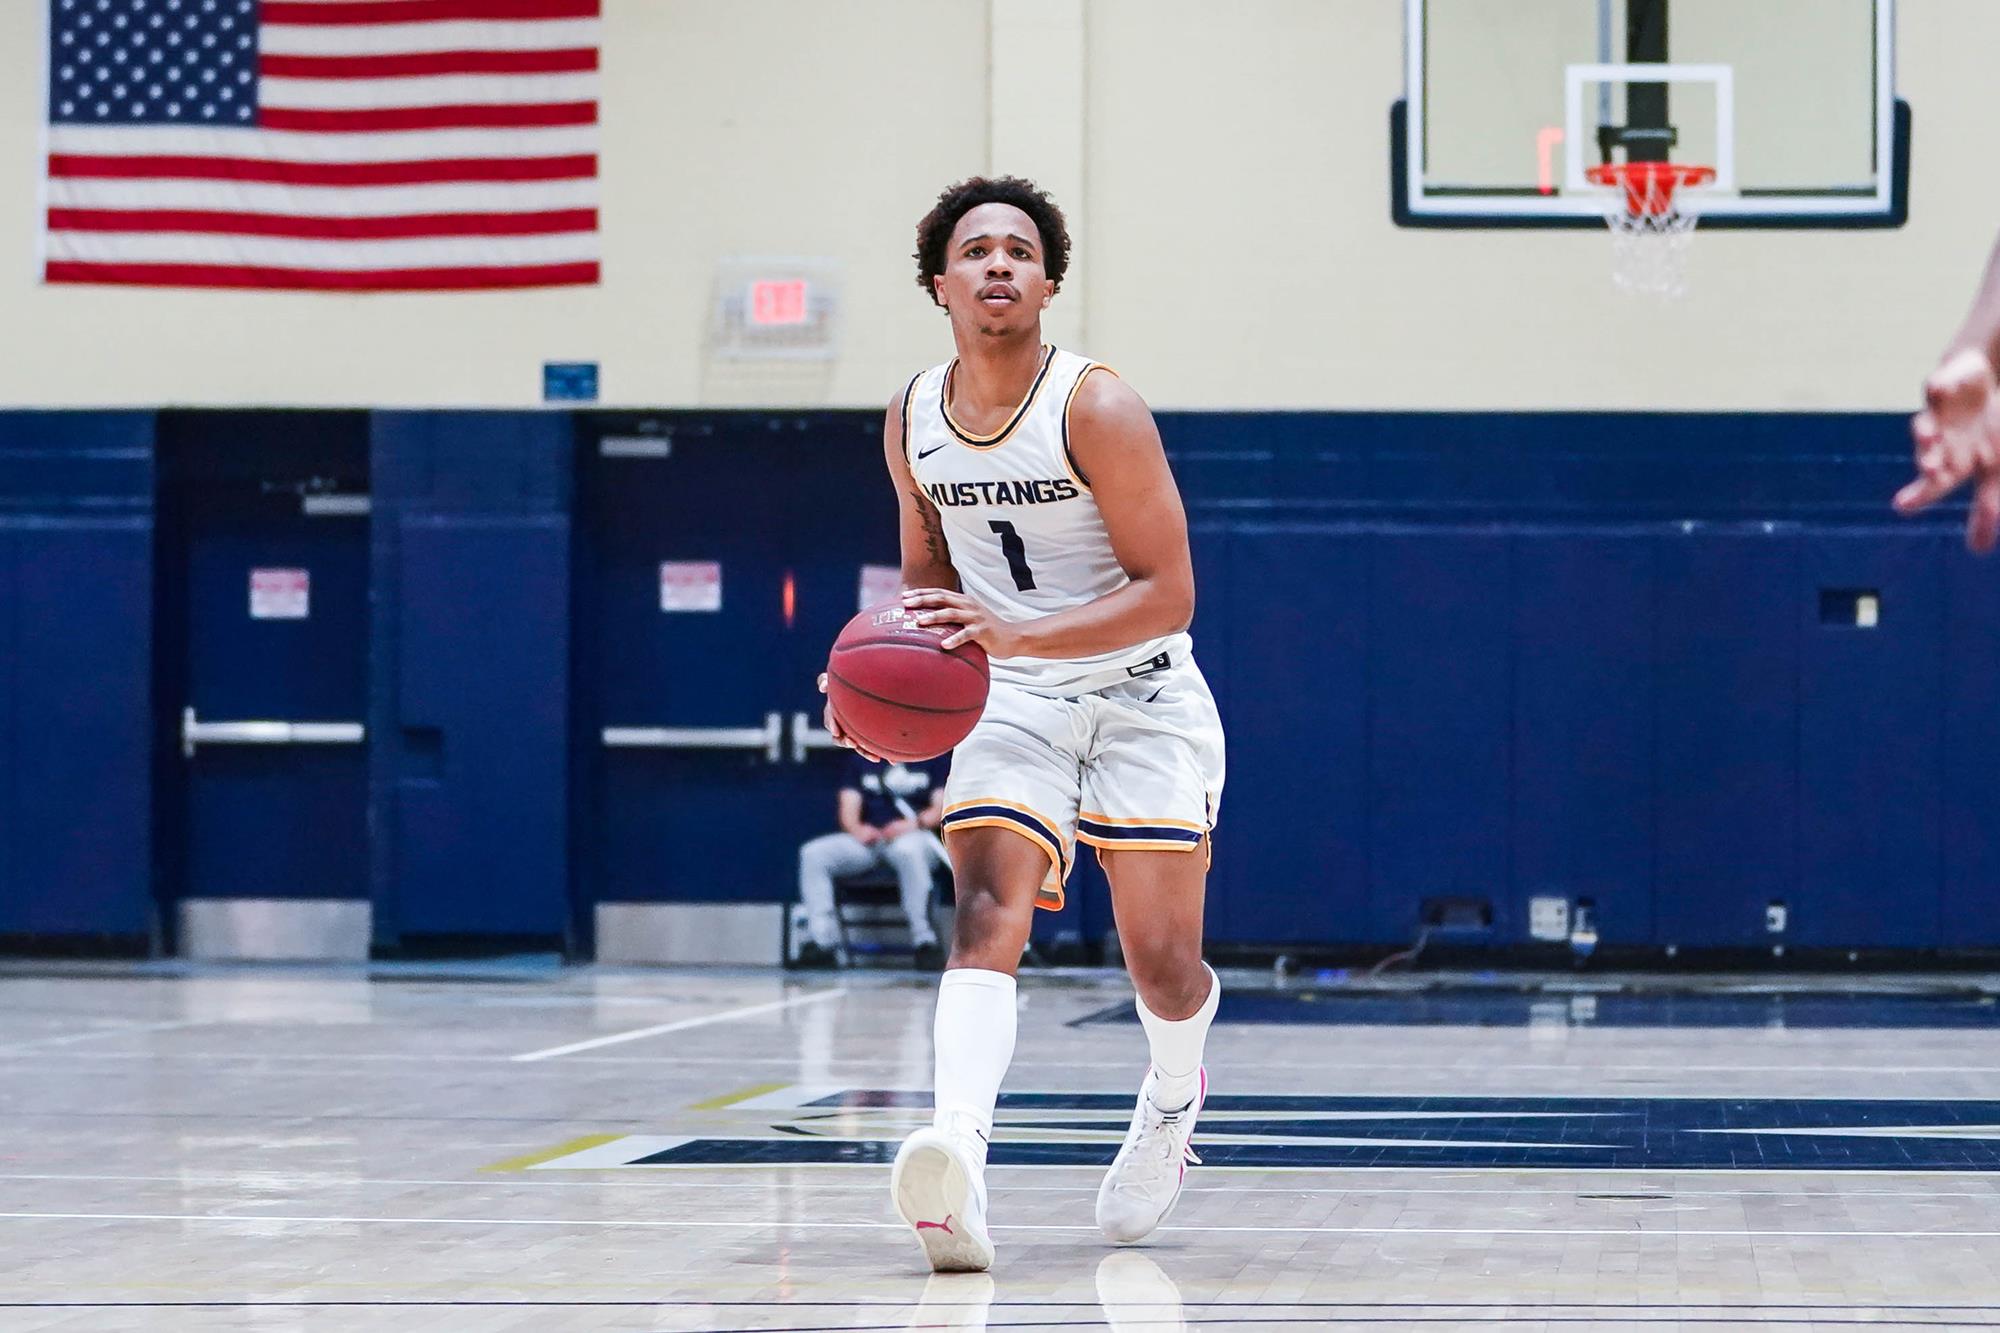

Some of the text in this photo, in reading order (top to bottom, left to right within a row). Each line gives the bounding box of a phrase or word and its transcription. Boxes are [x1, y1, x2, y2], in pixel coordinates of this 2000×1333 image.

[922, 478, 1080, 507] MUSTANGS
[987, 519, 1038, 593] 1
[1156, 654, 1165, 665] S
